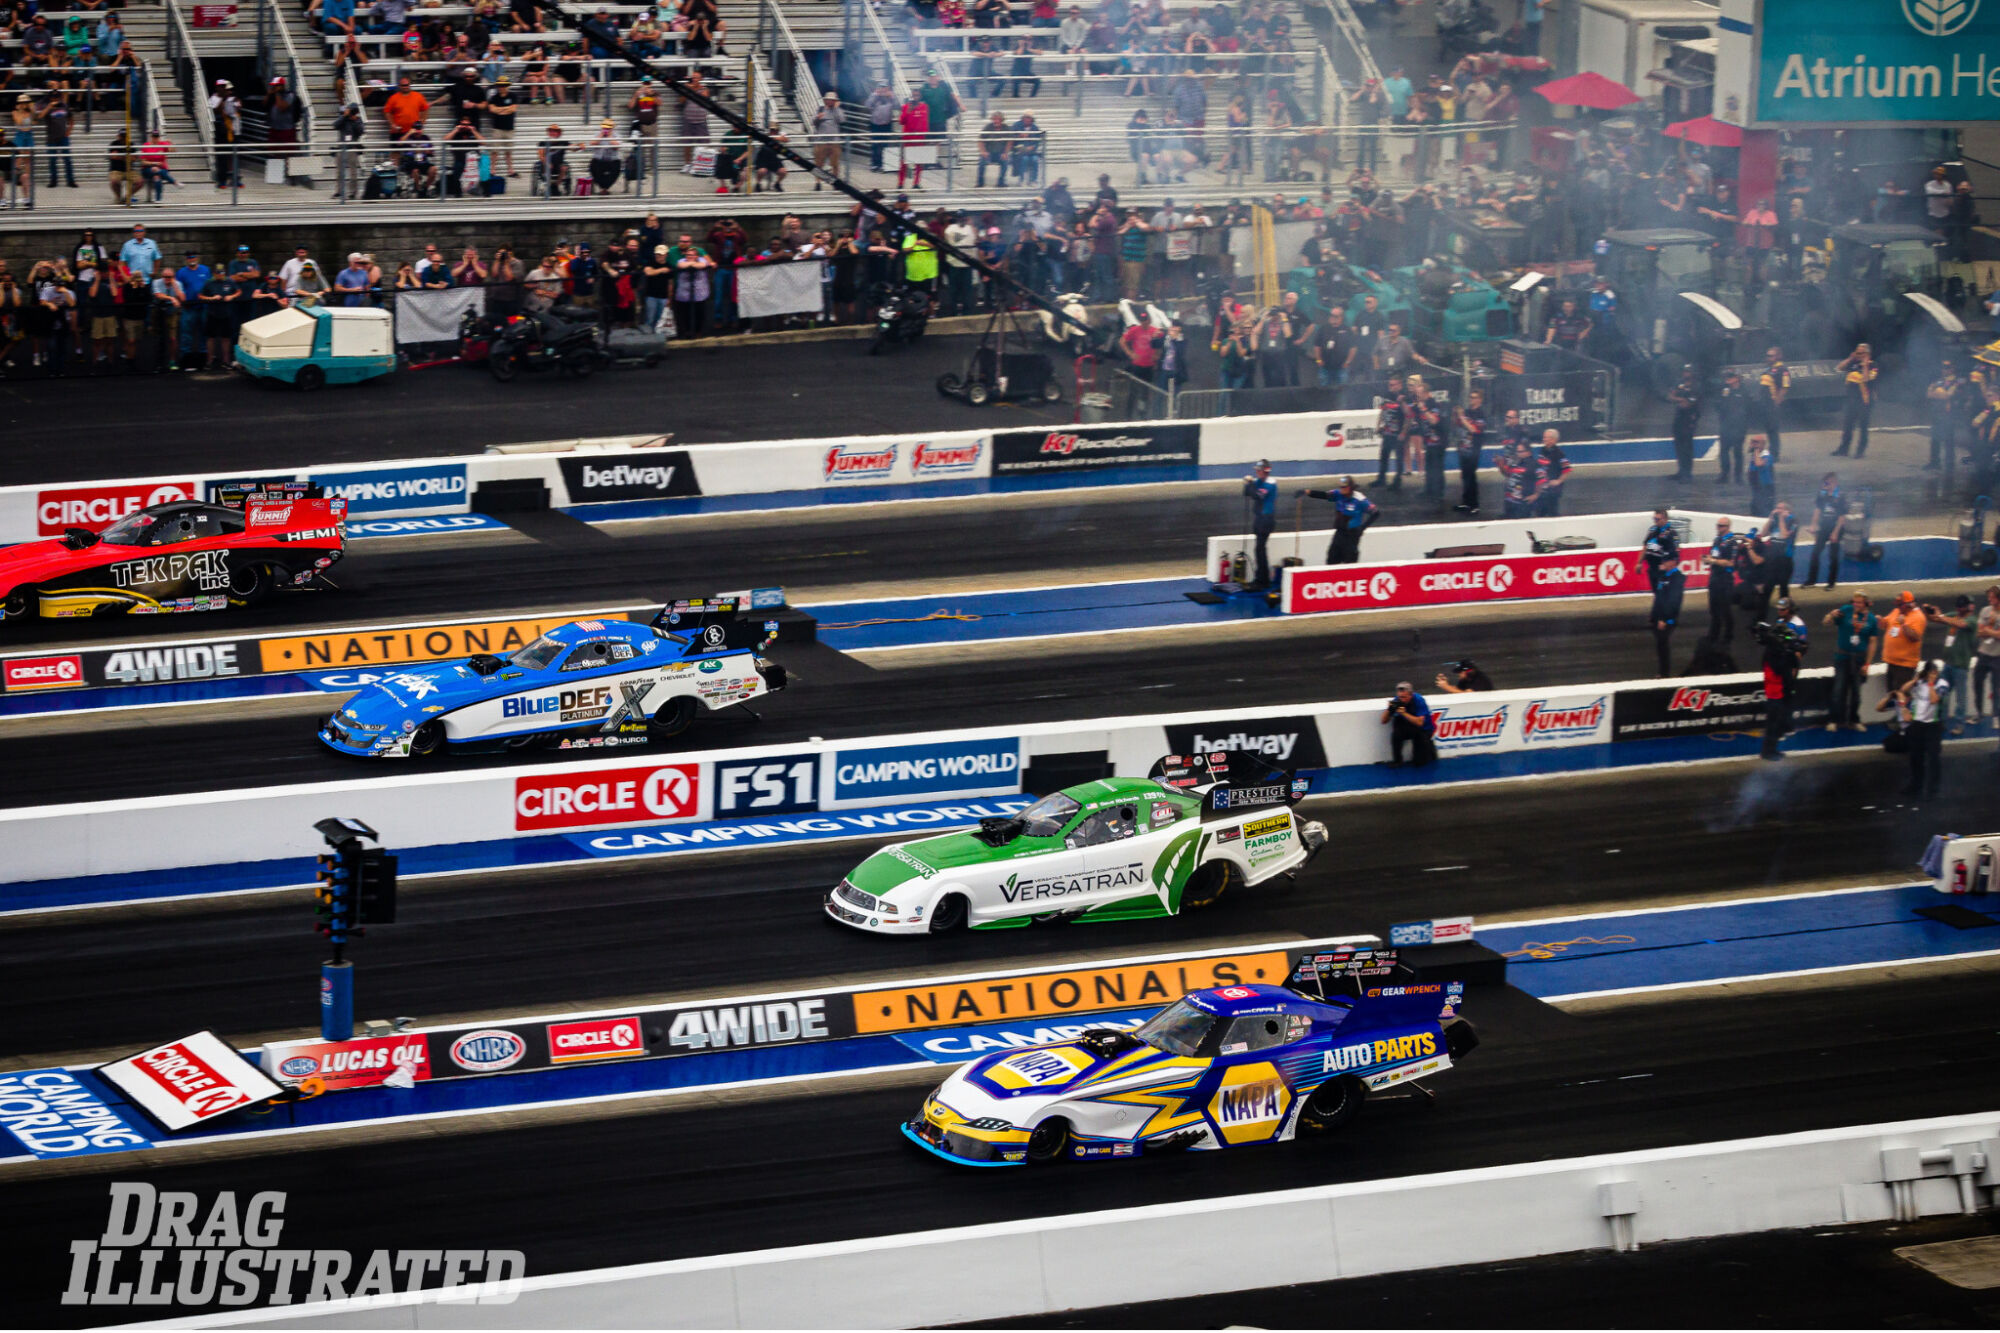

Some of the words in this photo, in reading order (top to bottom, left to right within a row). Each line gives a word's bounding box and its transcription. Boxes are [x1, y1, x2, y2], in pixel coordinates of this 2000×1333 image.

[1773, 54, 1942, 98] Atrium
[1519, 406, 1580, 425] PECIALIST
[825, 447, 895, 477] SUMMIT
[912, 442, 980, 472] SUMMIT
[323, 481, 396, 501] AMPING
[397, 475, 466, 496] WORLD
[583, 464, 676, 490] betway
[38, 496, 142, 526] CIRCLE
[287, 527, 337, 542] HEMI
[110, 556, 168, 588] TEK
[170, 549, 230, 581] PAK
[1419, 571, 1485, 592] CIRCLE
[1489, 567, 1510, 589] K
[1533, 564, 1596, 586] CIRCLE
[1602, 561, 1622, 583] K
[1679, 559, 1711, 576] CLE
[1301, 579, 1367, 601] CIRCLE
[1372, 575, 1394, 597] K
[304, 624, 541, 666] NATIONA
[10, 665, 57, 680] CIRCLE
[104, 643, 240, 683] 4WIDE
[1668, 686, 1711, 712] K1
[561, 708, 603, 721] PLATINUM
[1431, 707, 1506, 740] SUMMIT
[1524, 699, 1604, 739] SUMMIT
[1193, 731, 1299, 760] betway
[838, 758, 936, 785] CAMPING
[938, 752, 1017, 777] WORLD
[517, 780, 636, 817] CIRCLE
[647, 772, 685, 811] K
[720, 762, 818, 811] FS1
[1231, 786, 1286, 800] PRESTIGE
[590, 817, 844, 851] CAMPING
[838, 801, 1033, 828] WORLD
[1243, 816, 1289, 832] SOUTHERN
[1245, 830, 1293, 850] FARMBOY
[999, 868, 1145, 903] VERSATRAN
[907, 962, 1241, 1024] NATIONALS
[1382, 984, 1441, 997] GEARWRENCH
[556, 1030, 611, 1048] CIRCLE
[614, 1027, 632, 1044] K
[668, 999, 829, 1049] 4WIDE
[320, 1048, 390, 1073] LUCAS
[392, 1043, 426, 1066] OIL
[462, 1037, 514, 1064] NHRA
[1322, 1043, 1372, 1073] AUTO
[1374, 1032, 1436, 1063] PARTS
[143, 1047, 216, 1094] CIRCLE
[1006, 1051, 1071, 1083] NAPA
[22, 1072, 145, 1148] CAMPING
[1223, 1083, 1278, 1122] NAPA
